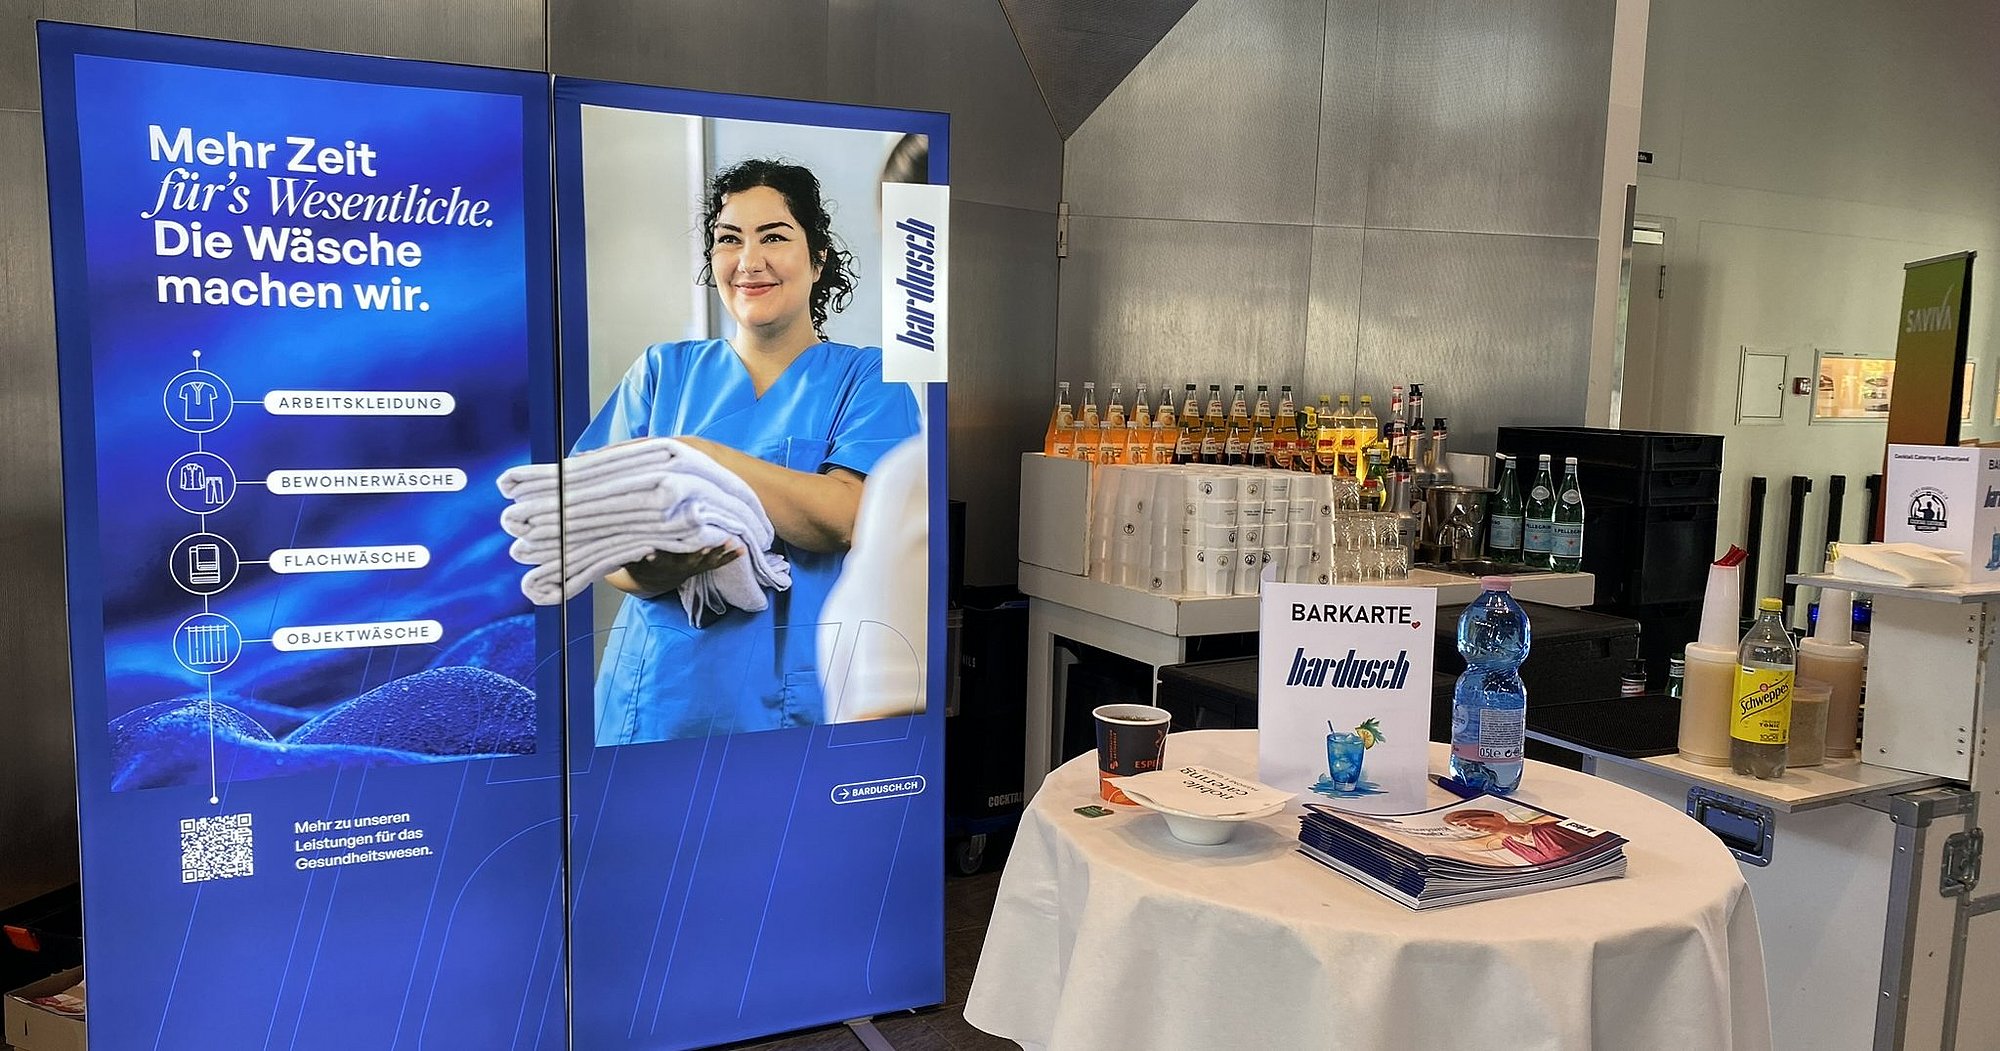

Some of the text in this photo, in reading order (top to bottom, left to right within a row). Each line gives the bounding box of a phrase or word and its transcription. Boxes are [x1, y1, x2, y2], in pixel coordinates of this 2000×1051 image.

[149, 125, 377, 177] Mehr Zeit
[267, 176, 494, 228] Wesentliche.
[155, 219, 422, 268] Die Wäsche
[157, 272, 430, 312] machen wir.
[896, 217, 935, 352] bardusch
[279, 397, 442, 410] ARBEITSKLEIDUNG
[282, 473, 454, 488] BEWOHNERWÄSCHE
[285, 551, 416, 567] FLACHWÄSCHE
[1291, 604, 1412, 624] BARKARTE
[287, 626, 429, 645] OBJEKTWÄSCHE
[1286, 648, 1410, 689] bardusch
[1741, 683, 1789, 715] Schweppes
[852, 782, 918, 796] BARDUSCH.CH
[294, 813, 410, 834] Mehr zu unseren
[295, 829, 423, 852] Leistungen für das
[295, 846, 433, 870] Gesundheitswesen.
